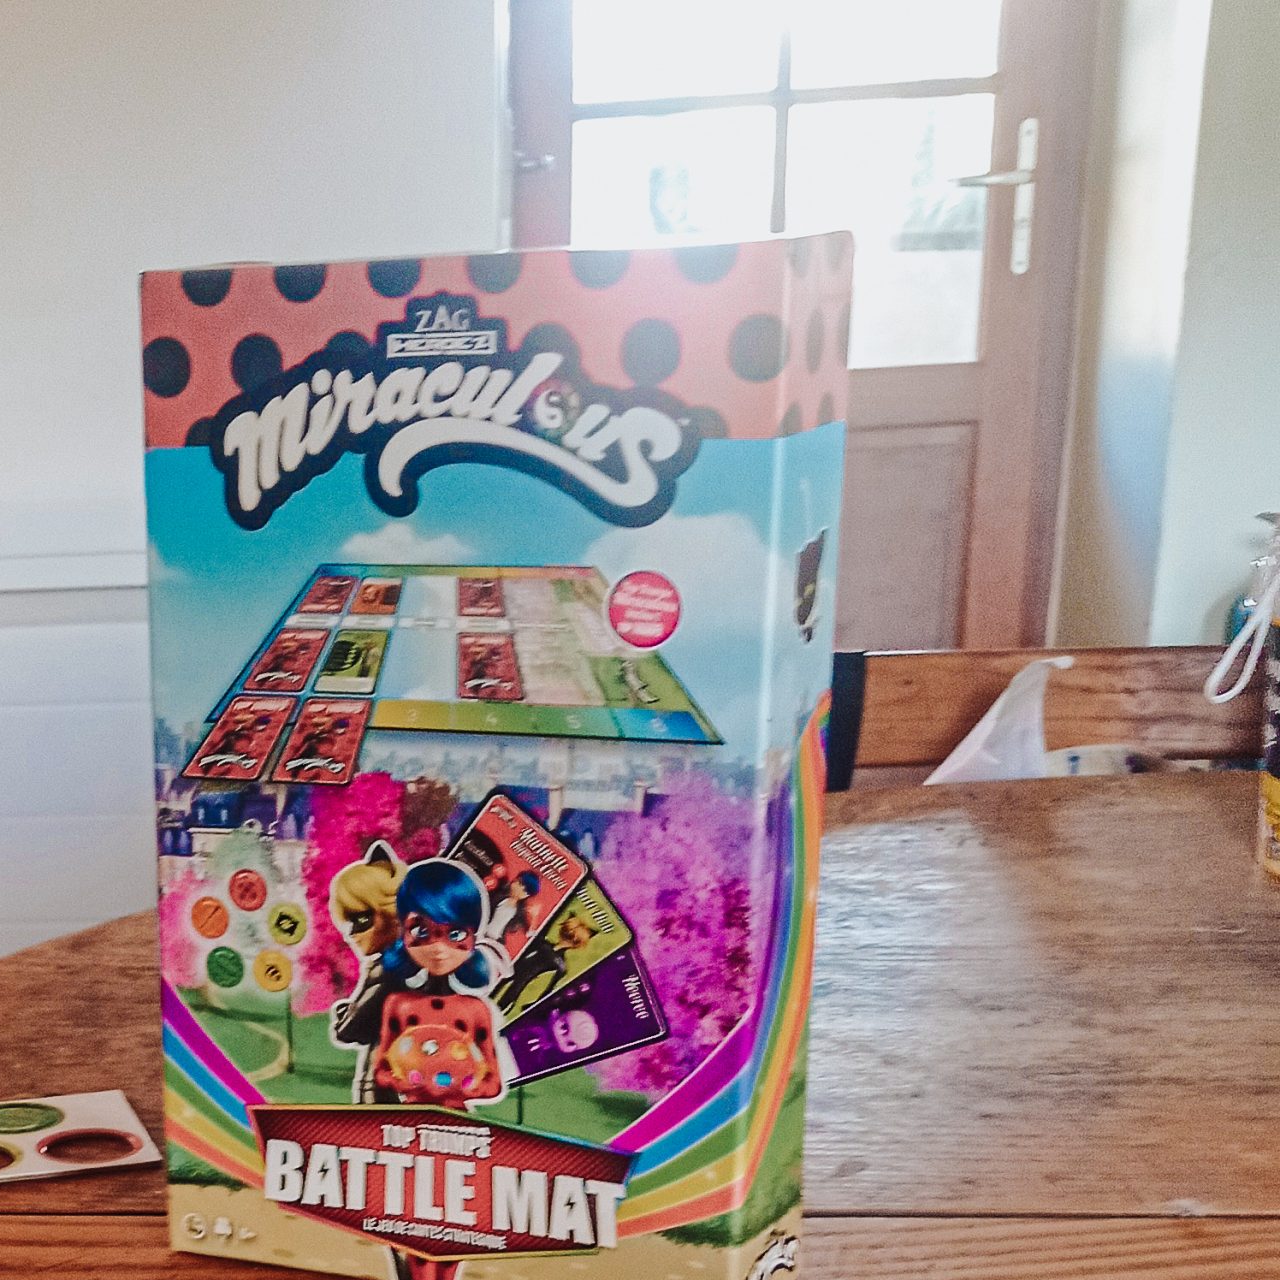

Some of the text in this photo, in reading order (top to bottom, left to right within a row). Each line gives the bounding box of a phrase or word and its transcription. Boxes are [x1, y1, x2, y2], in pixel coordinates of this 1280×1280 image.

[414, 305, 470, 332] ZAG
[265, 1138, 626, 1250] BATTLE MAT
